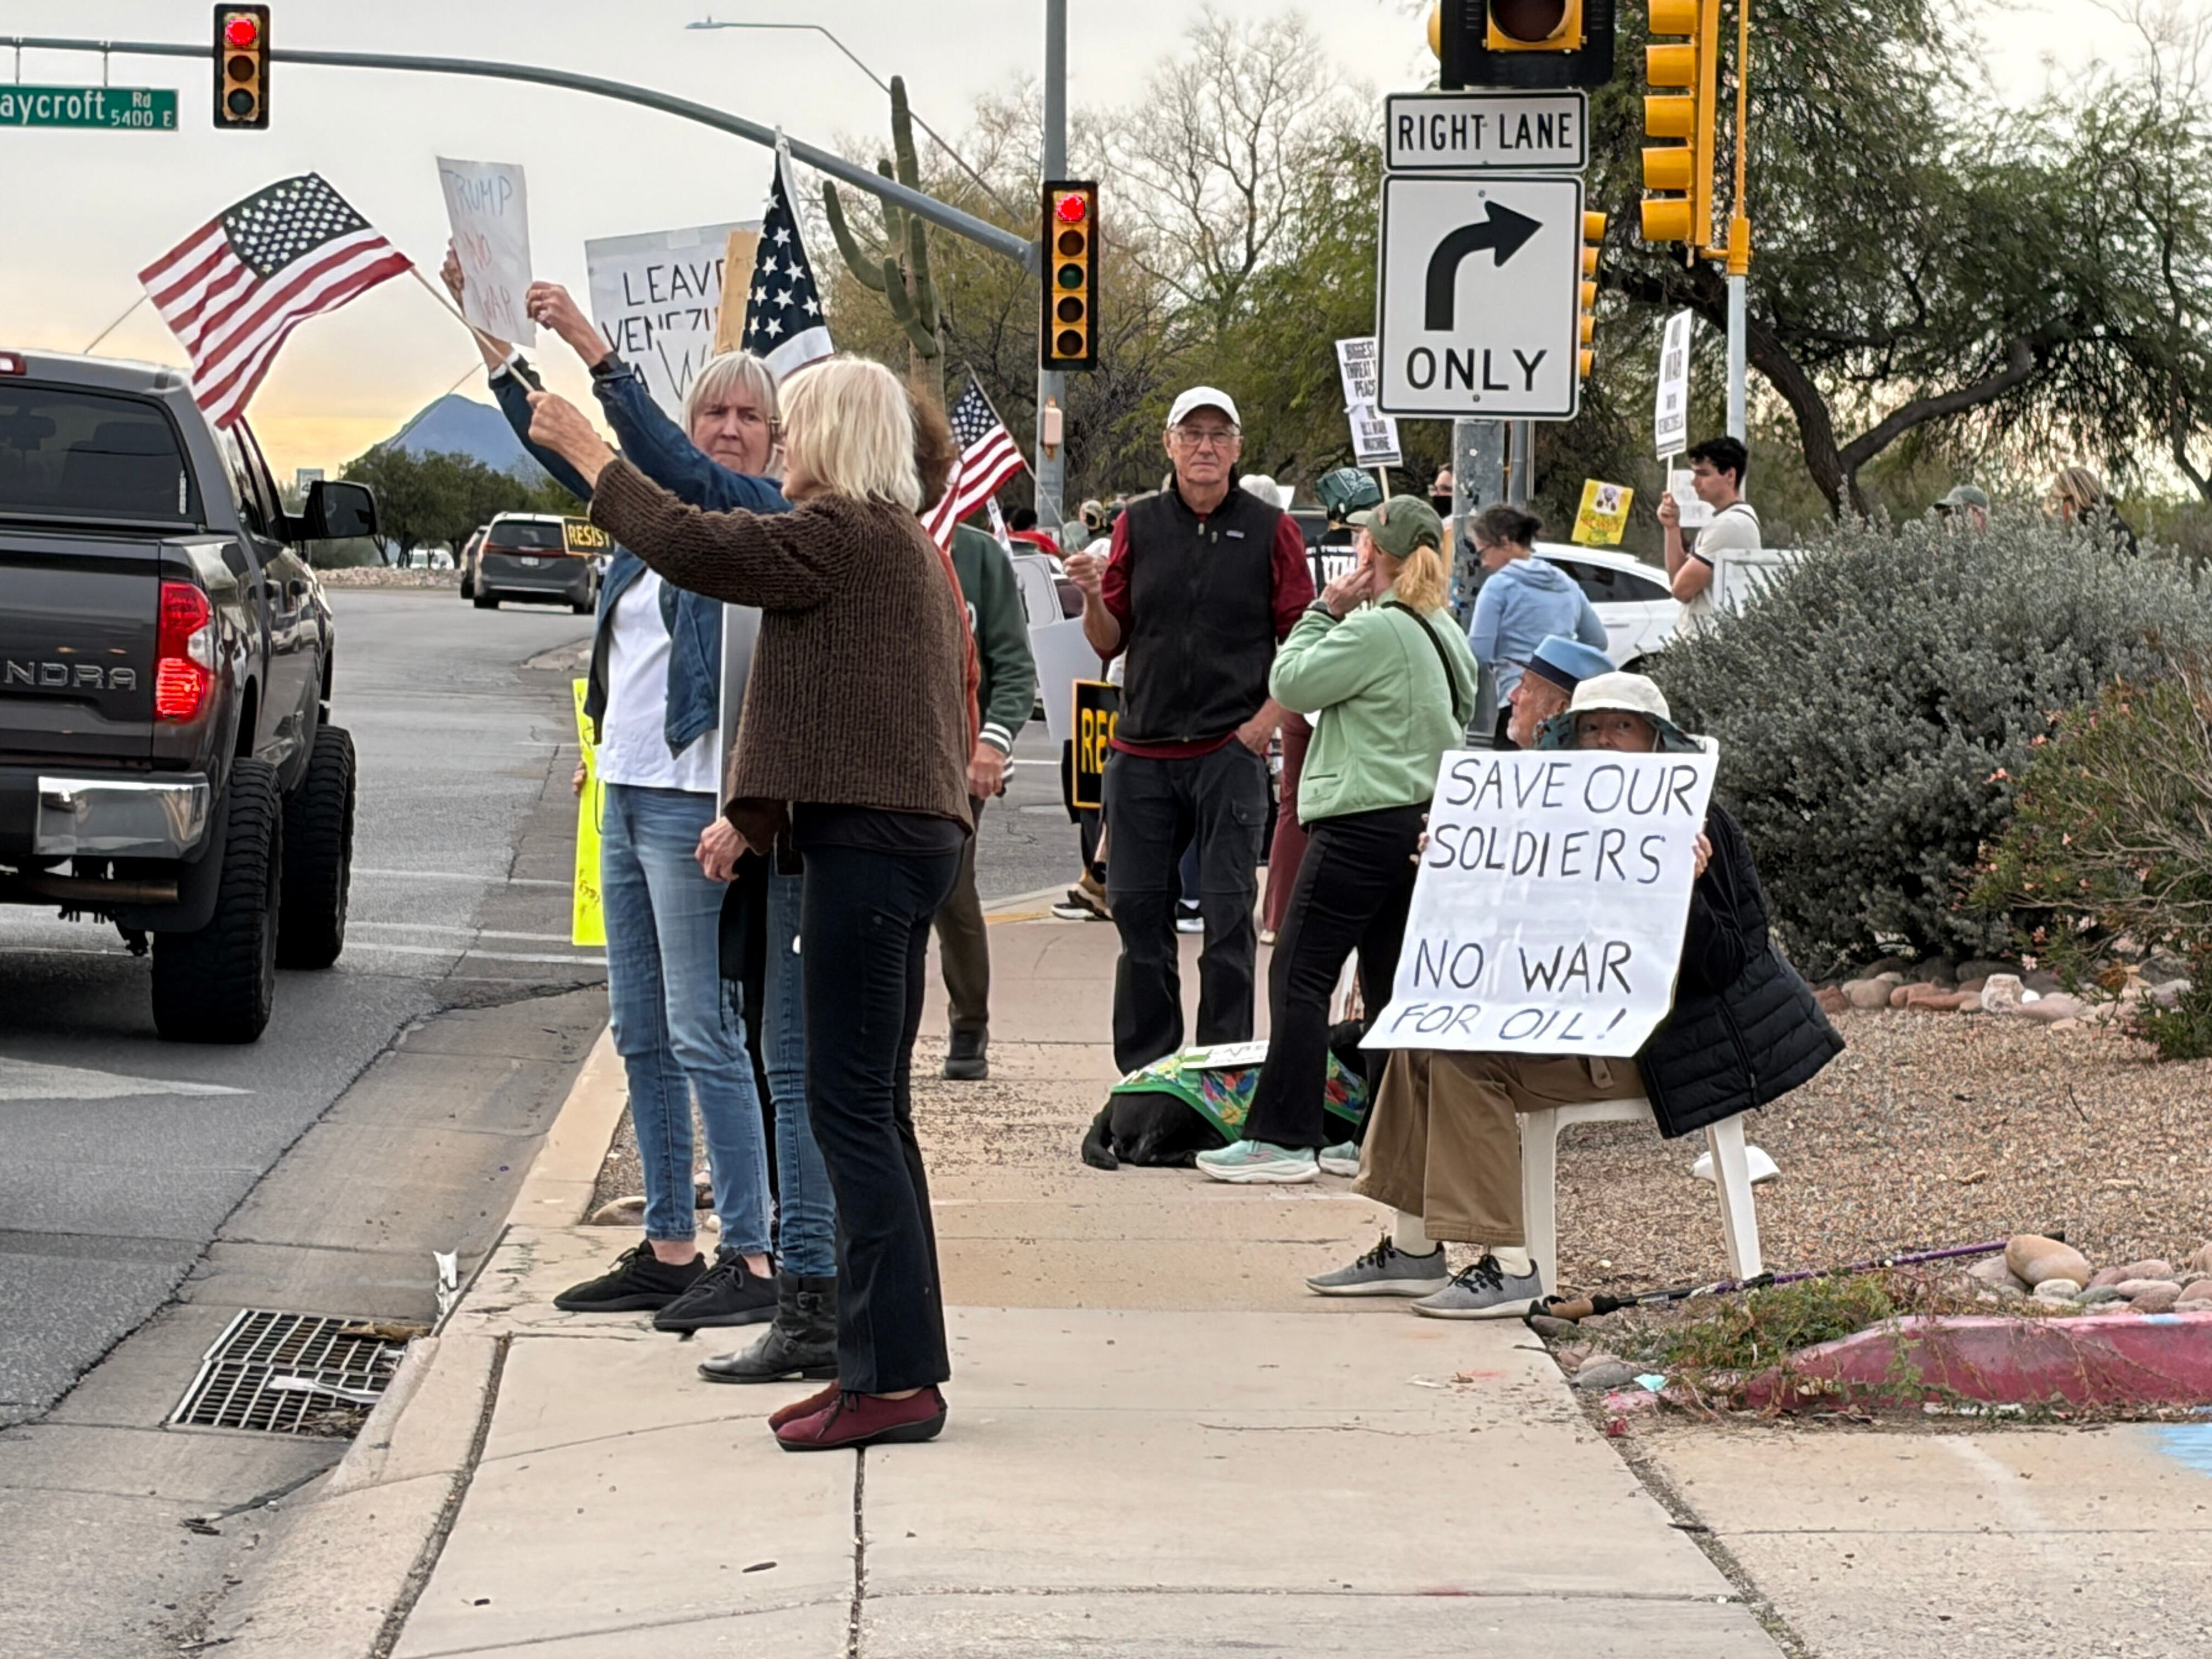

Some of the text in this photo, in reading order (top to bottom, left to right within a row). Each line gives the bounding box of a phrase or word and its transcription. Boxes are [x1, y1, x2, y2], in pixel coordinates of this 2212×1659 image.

[1, 90, 152, 126] aycroft Rd
[111, 109, 173, 127] 5400 E
[1398, 113, 1572, 151] RIGHT LANE
[440, 168, 513, 217] TRUMP
[1406, 346, 1548, 392] ONLY
[3, 659, 137, 691] NDRA
[1446, 758, 1698, 816] SAVE OUR
[1428, 824, 1666, 884] SOLDIERS
[1414, 938, 1632, 994] NO WAR
[1390, 1003, 1627, 1041] FOR OIL!
